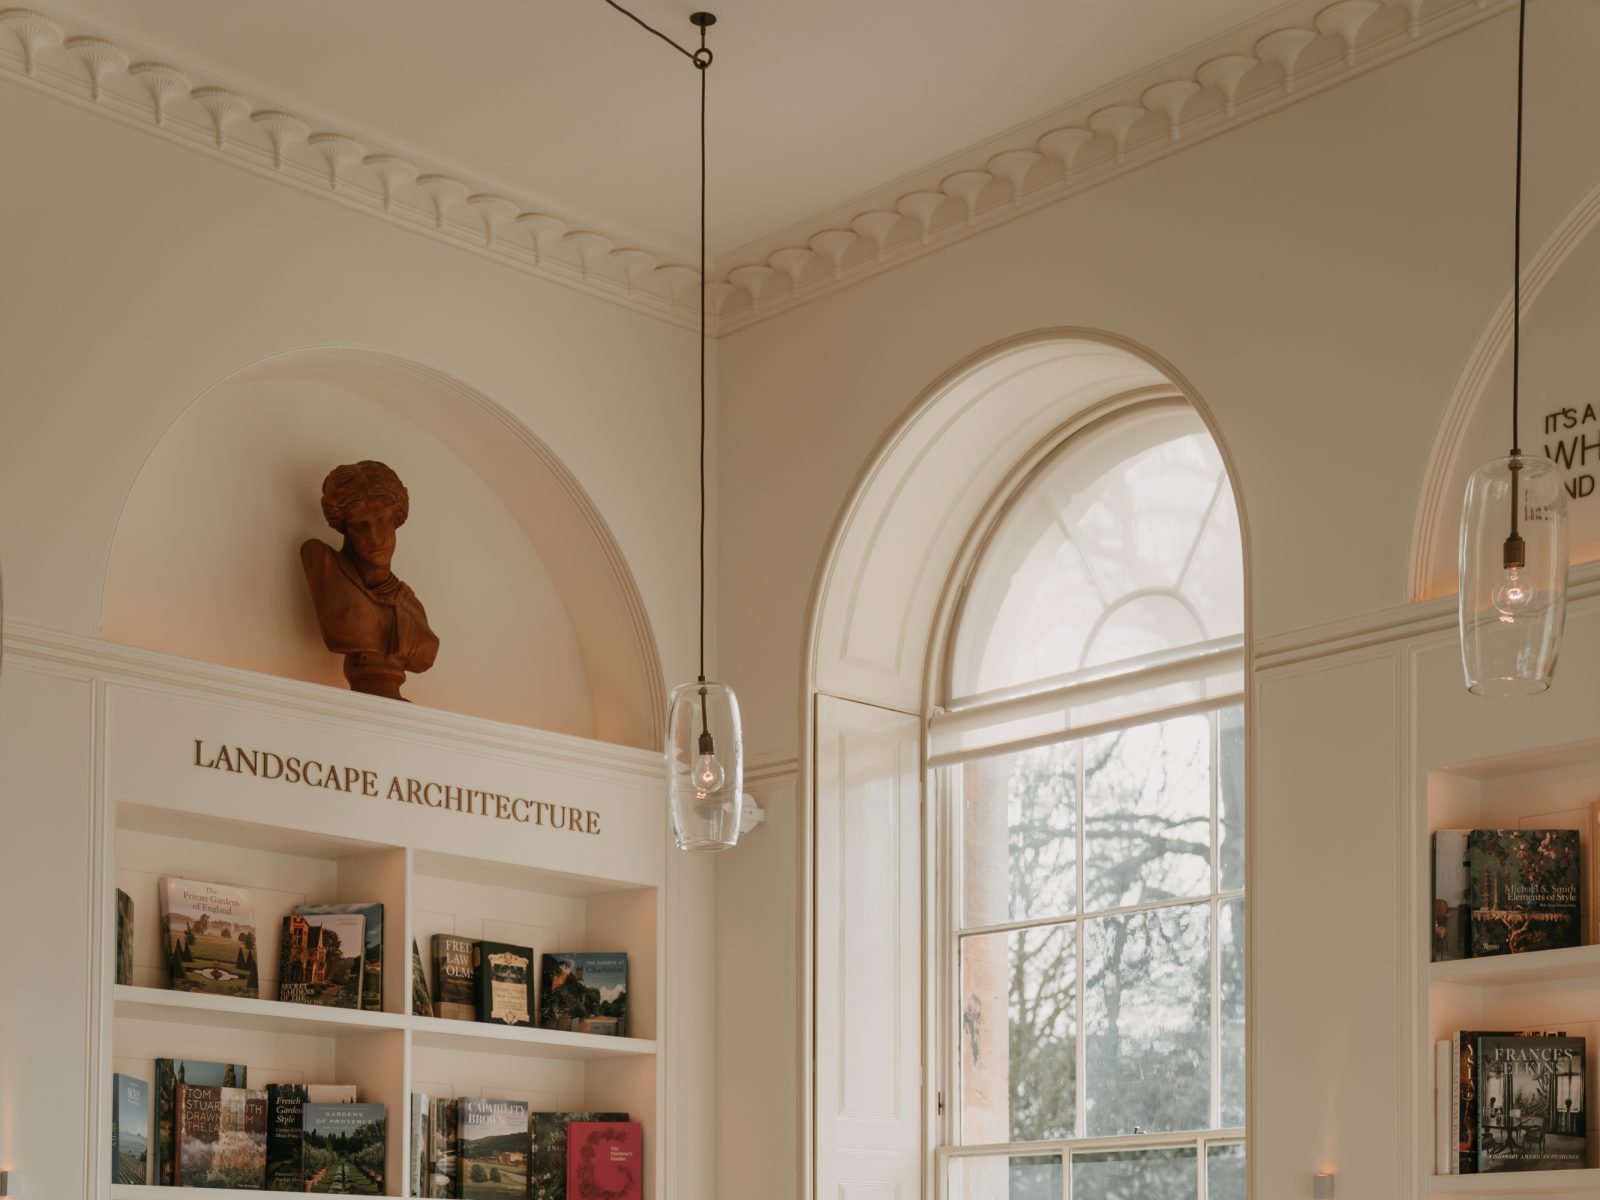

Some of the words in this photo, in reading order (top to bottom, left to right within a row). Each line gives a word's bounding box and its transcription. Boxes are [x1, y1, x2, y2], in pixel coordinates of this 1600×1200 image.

[1544, 407, 1578, 435] IT'S
[1581, 402, 1597, 425] A
[193, 739, 379, 798] LANDSCAPE
[386, 775, 601, 835] ARCHITECTURE
[205, 887, 218, 895] The
[1504, 883, 1538, 893] Michael
[1551, 884, 1576, 894] Smith
[183, 890, 209, 904] Private
[210, 895, 240, 908] Gardens
[1507, 892, 1545, 901] Elements
[1546, 892, 1556, 901] of
[1556, 892, 1577, 903] Style
[192, 901, 201, 910] of
[202, 903, 232, 916] England
[446, 952, 469, 966] LAW
[1494, 1048, 1573, 1062] FRANCES
[1503, 1062, 1564, 1075] ELKINS
[186, 1088, 211, 1100] TOM
[276, 1096, 301, 1105] French
[468, 1101, 525, 1116] CAPABILITY
[186, 1121, 207, 1132] THE
[275, 1115, 295, 1125] Style
